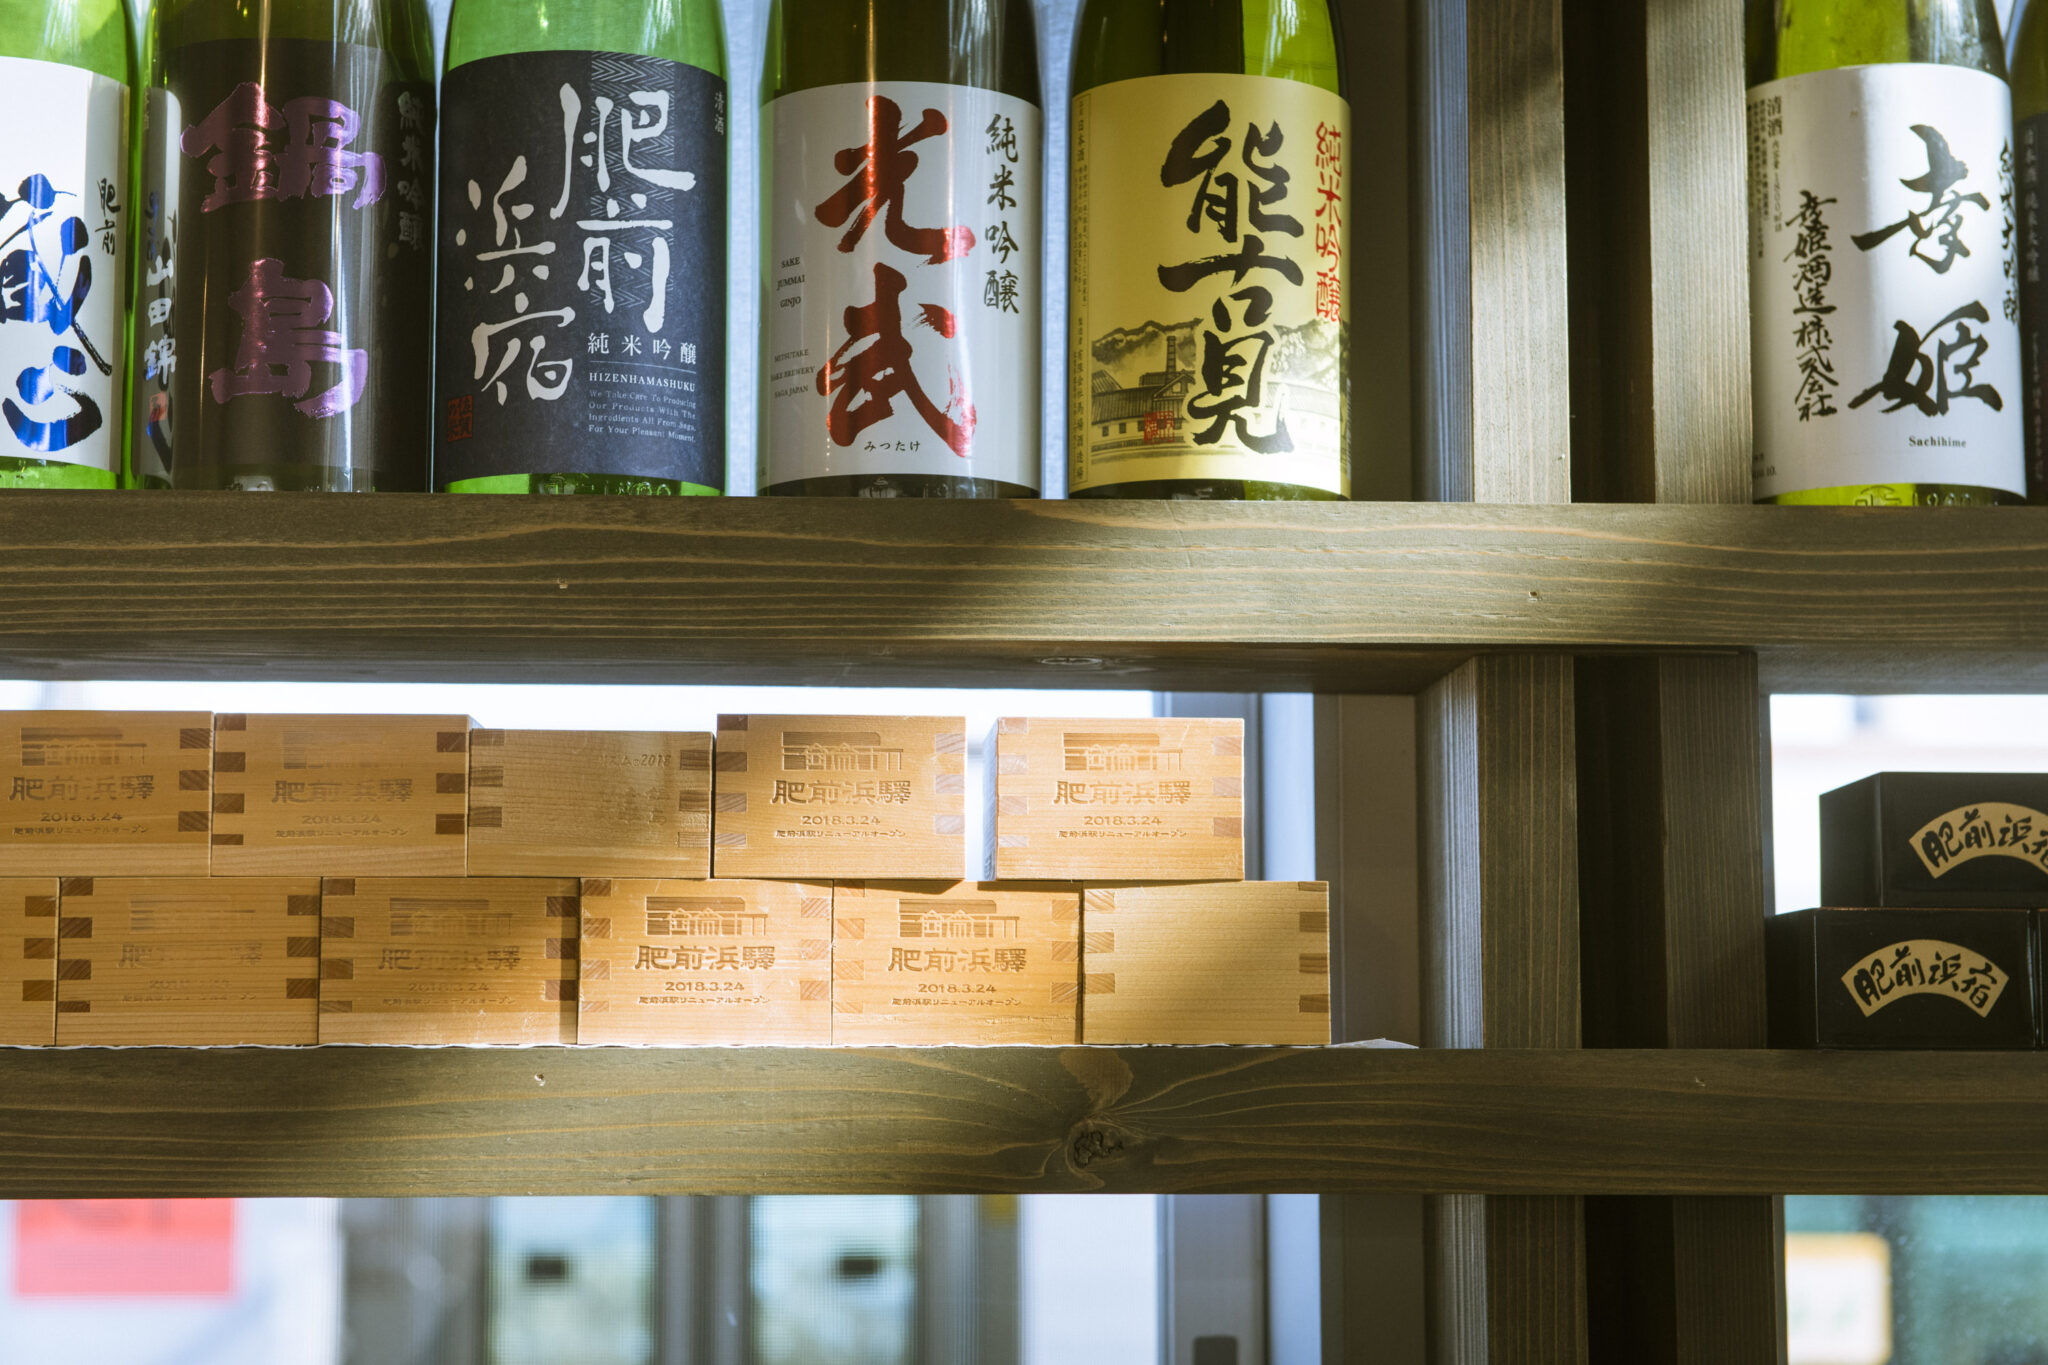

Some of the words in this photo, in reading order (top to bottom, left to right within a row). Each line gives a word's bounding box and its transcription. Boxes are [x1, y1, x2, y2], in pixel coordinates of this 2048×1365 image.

[1767, 95, 1784, 137] 清酒
[550, 83, 697, 333] 肥前
[984, 113, 1021, 314] 純米吟醸
[181, 82, 386, 418] 鍋島
[781, 257, 801, 269] SAKE
[815, 95, 977, 458] 光武
[1158, 99, 1305, 454] 能古見
[1849, 124, 2003, 417] 幸姫
[780, 296, 802, 309] GINJO
[144, 255, 177, 384] 山田錦
[587, 332, 697, 365] 純米吟醸
[589, 372, 696, 392] HIZENHAMASHUKU
[588, 401, 606, 410] Our
[588, 424, 604, 433] For
[608, 425, 629, 435] Your
[864, 440, 921, 452] みつたけ
[1908, 435, 1967, 448] Sachihime
[40, 812, 123, 822] 2018.3.24
[802, 815, 881, 825] 2018.3.24
[1084, 815, 1162, 825] 2018.3.24
[664, 981, 745, 992] 2018.3.24
[918, 983, 997, 993] 2018.3.24
